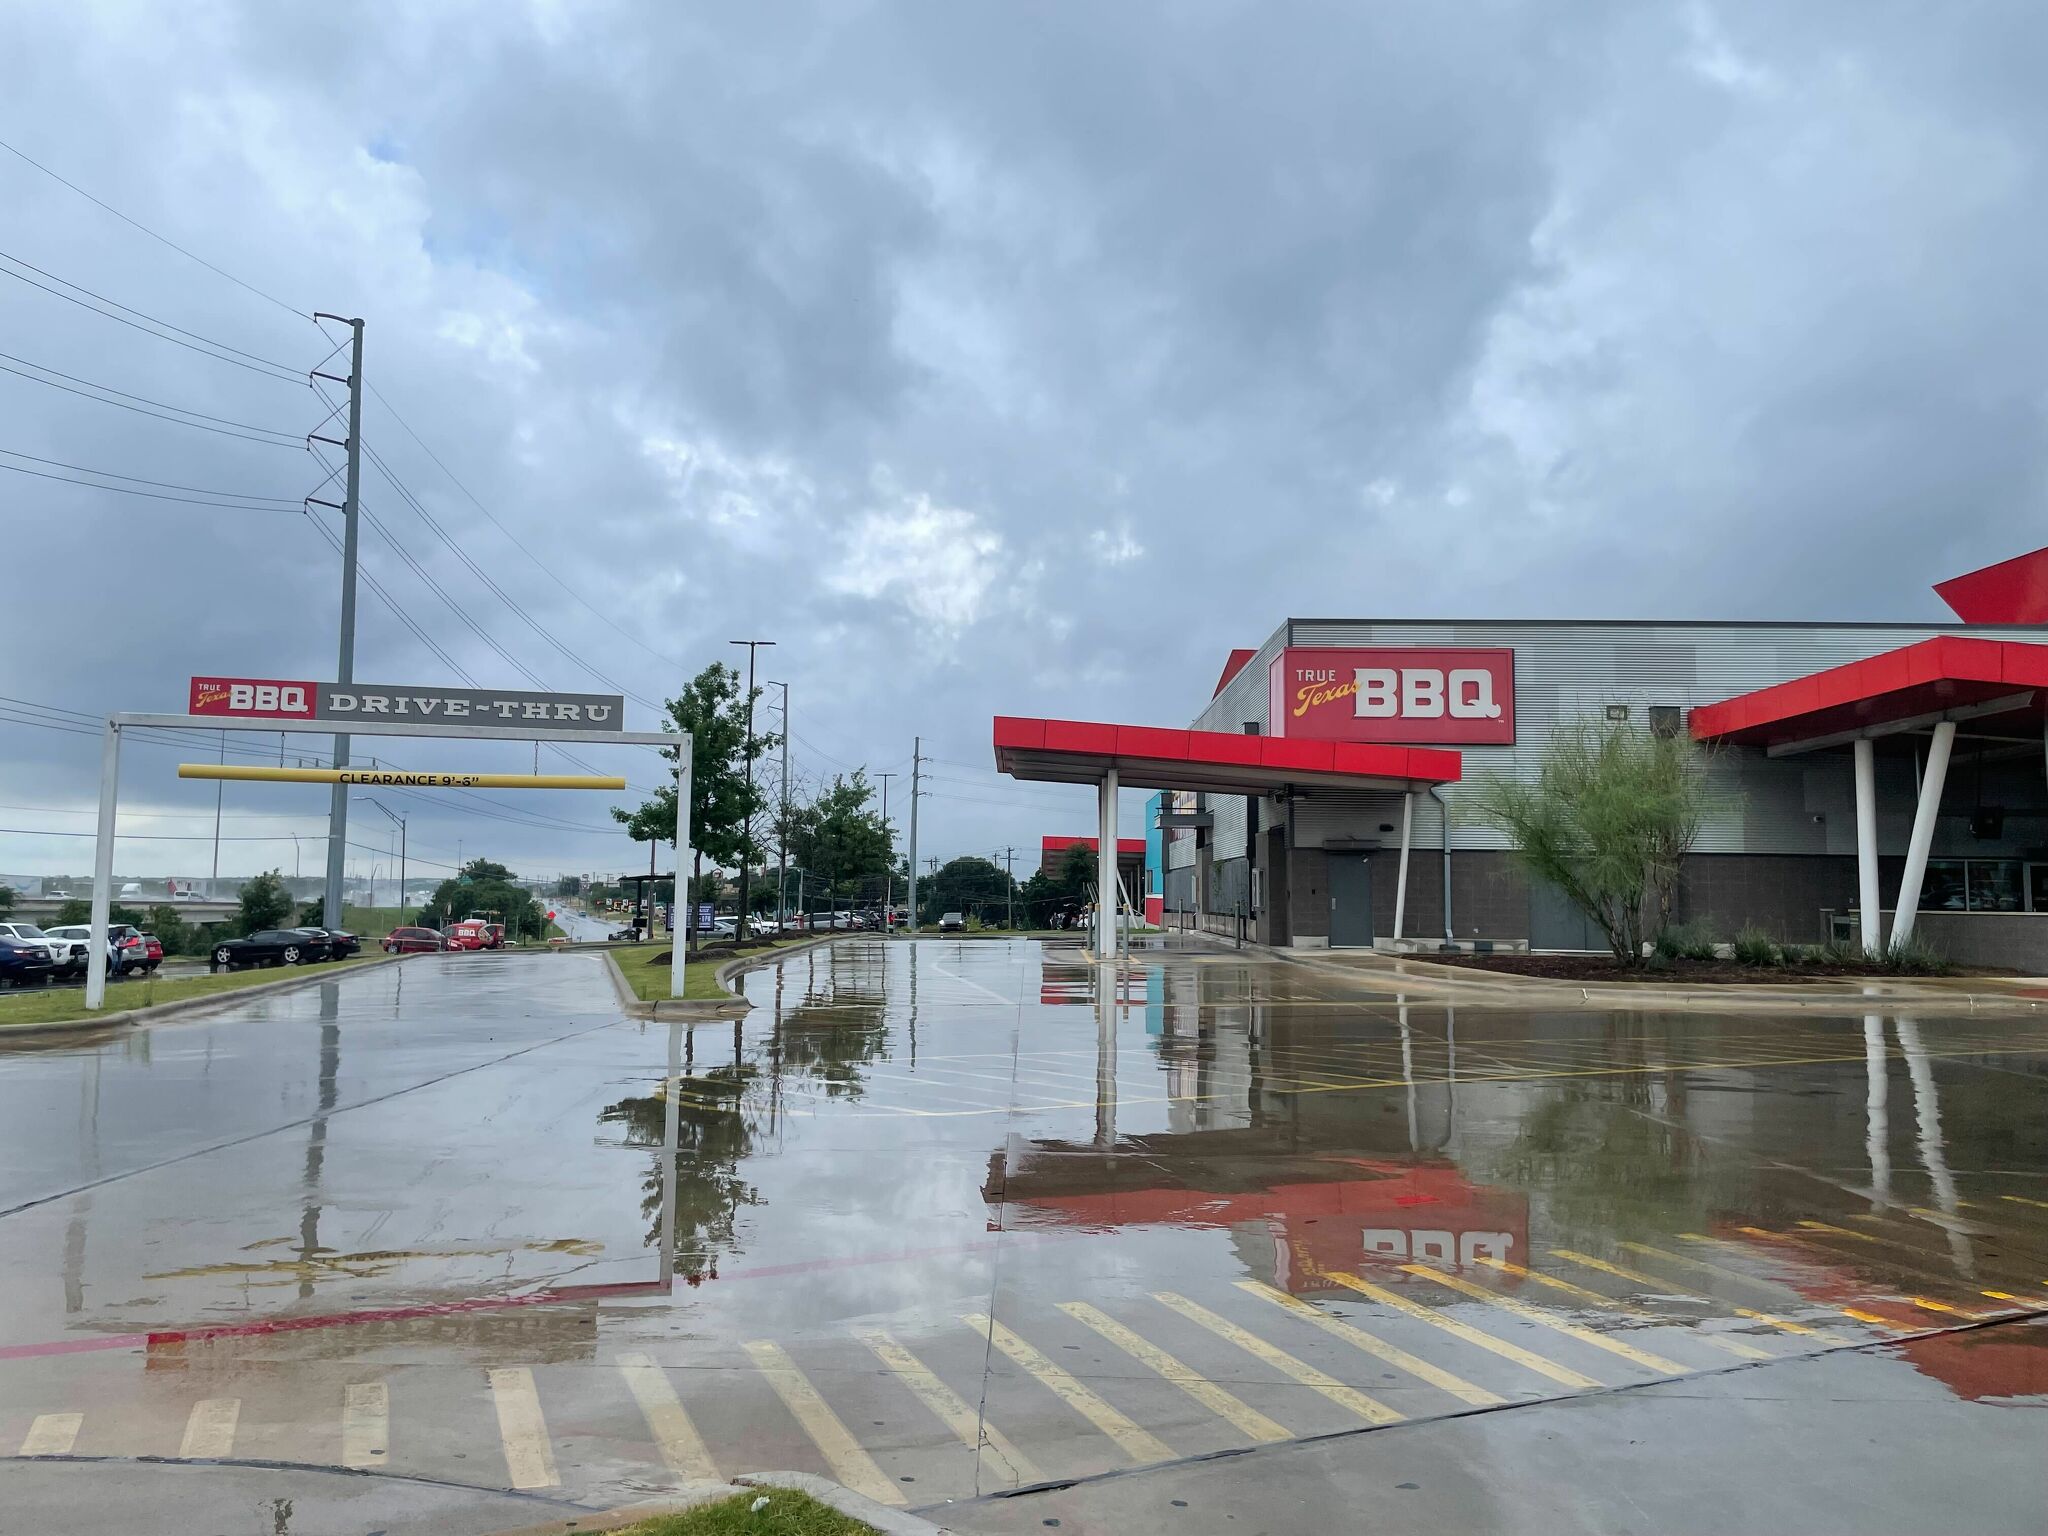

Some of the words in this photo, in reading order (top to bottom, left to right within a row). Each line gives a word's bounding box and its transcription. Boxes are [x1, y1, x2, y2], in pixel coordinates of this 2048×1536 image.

[1296, 669, 1336, 682] TRUE
[195, 690, 234, 708] Texas
[229, 684, 309, 712] BBQ
[1293, 679, 1363, 717] Texas
[1353, 668, 1501, 719] BBQ
[329, 694, 612, 722] DRIVE-THRU
[340, 773, 437, 785] CLEARANCE
